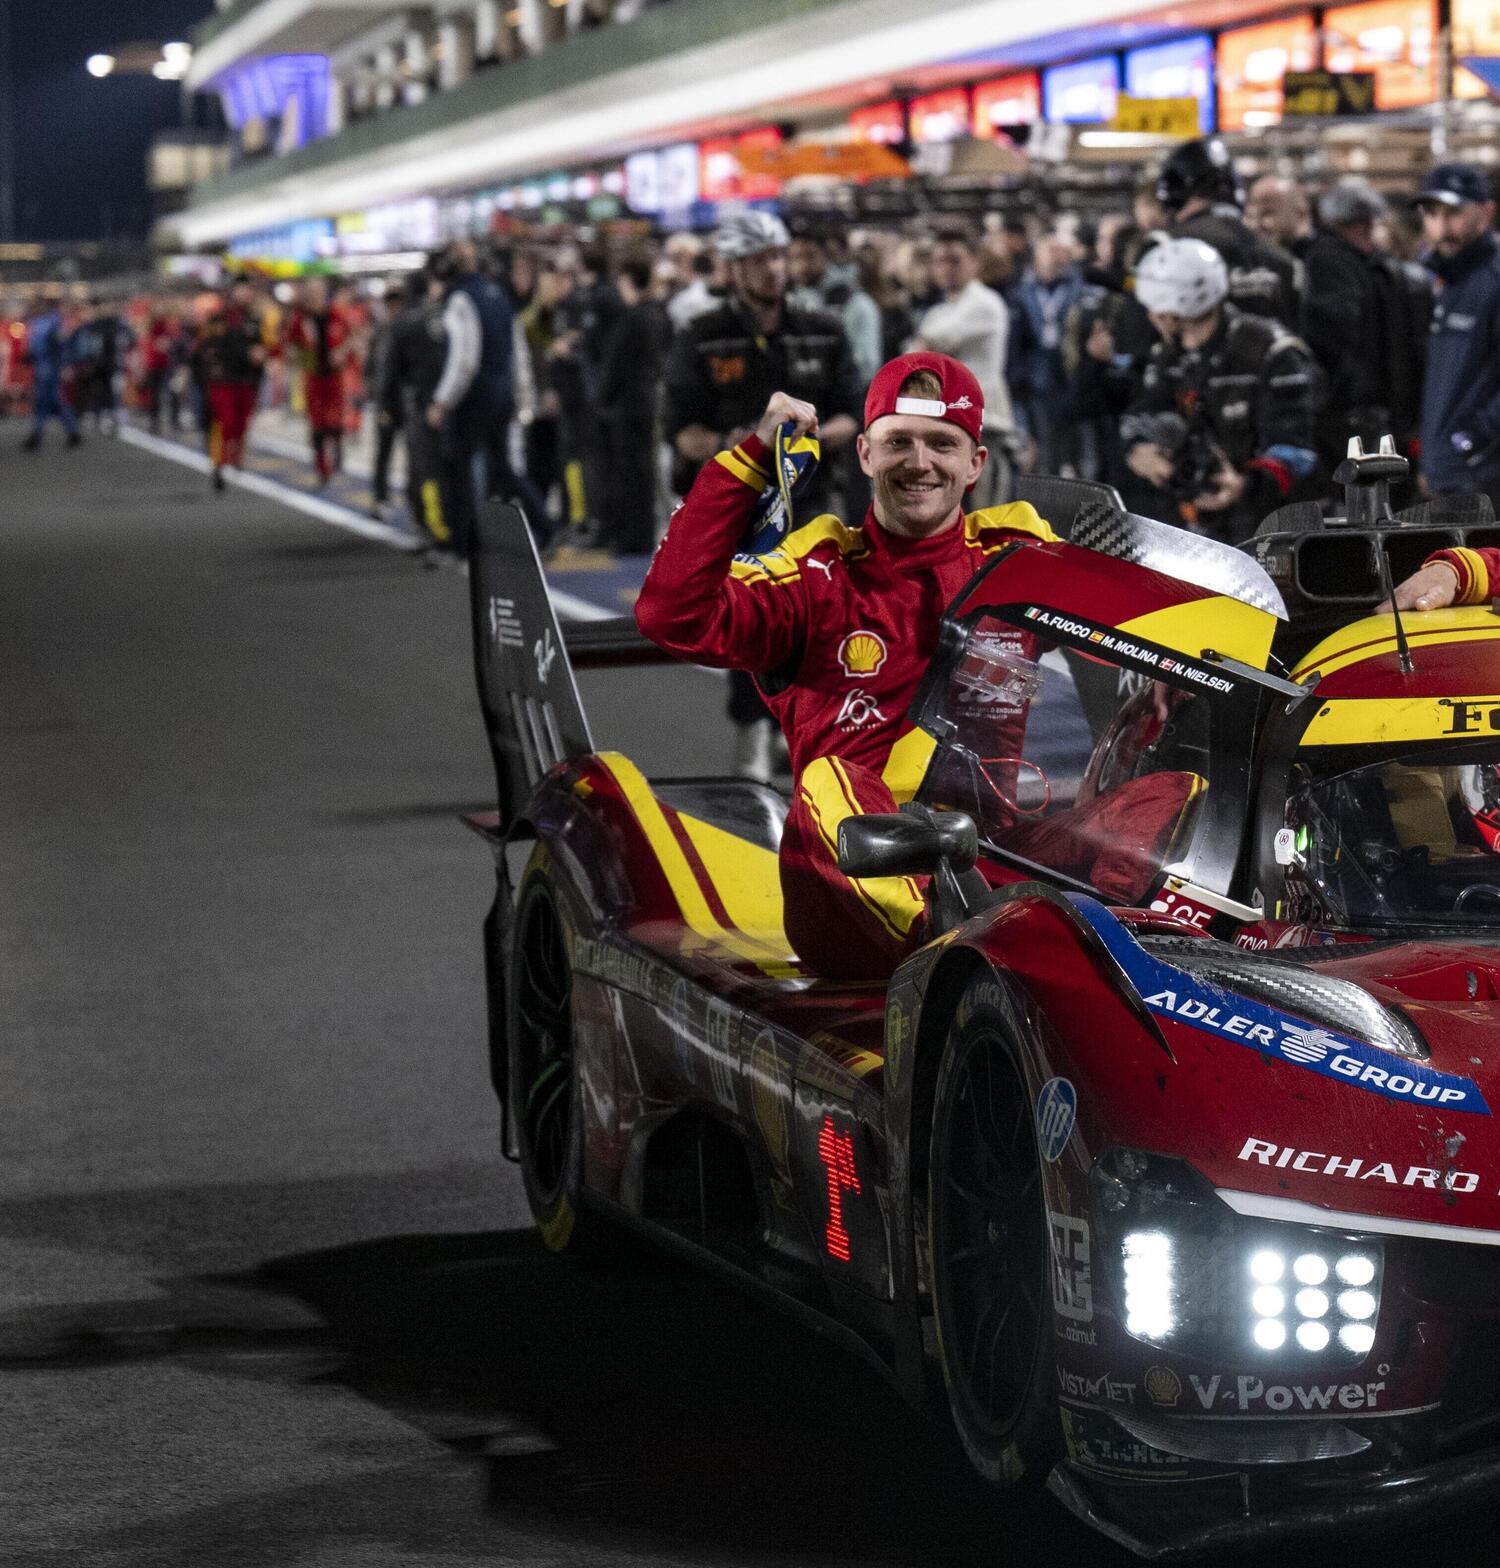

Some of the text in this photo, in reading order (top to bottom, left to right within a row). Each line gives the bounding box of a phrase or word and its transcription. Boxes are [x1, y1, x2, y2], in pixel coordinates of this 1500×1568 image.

[1142, 989, 1467, 1104] ADLER GROUP
[1040, 1098, 1072, 1151] hp
[1237, 1136, 1480, 1194] RICHARD
[1188, 1374, 1387, 1411] V-Power
